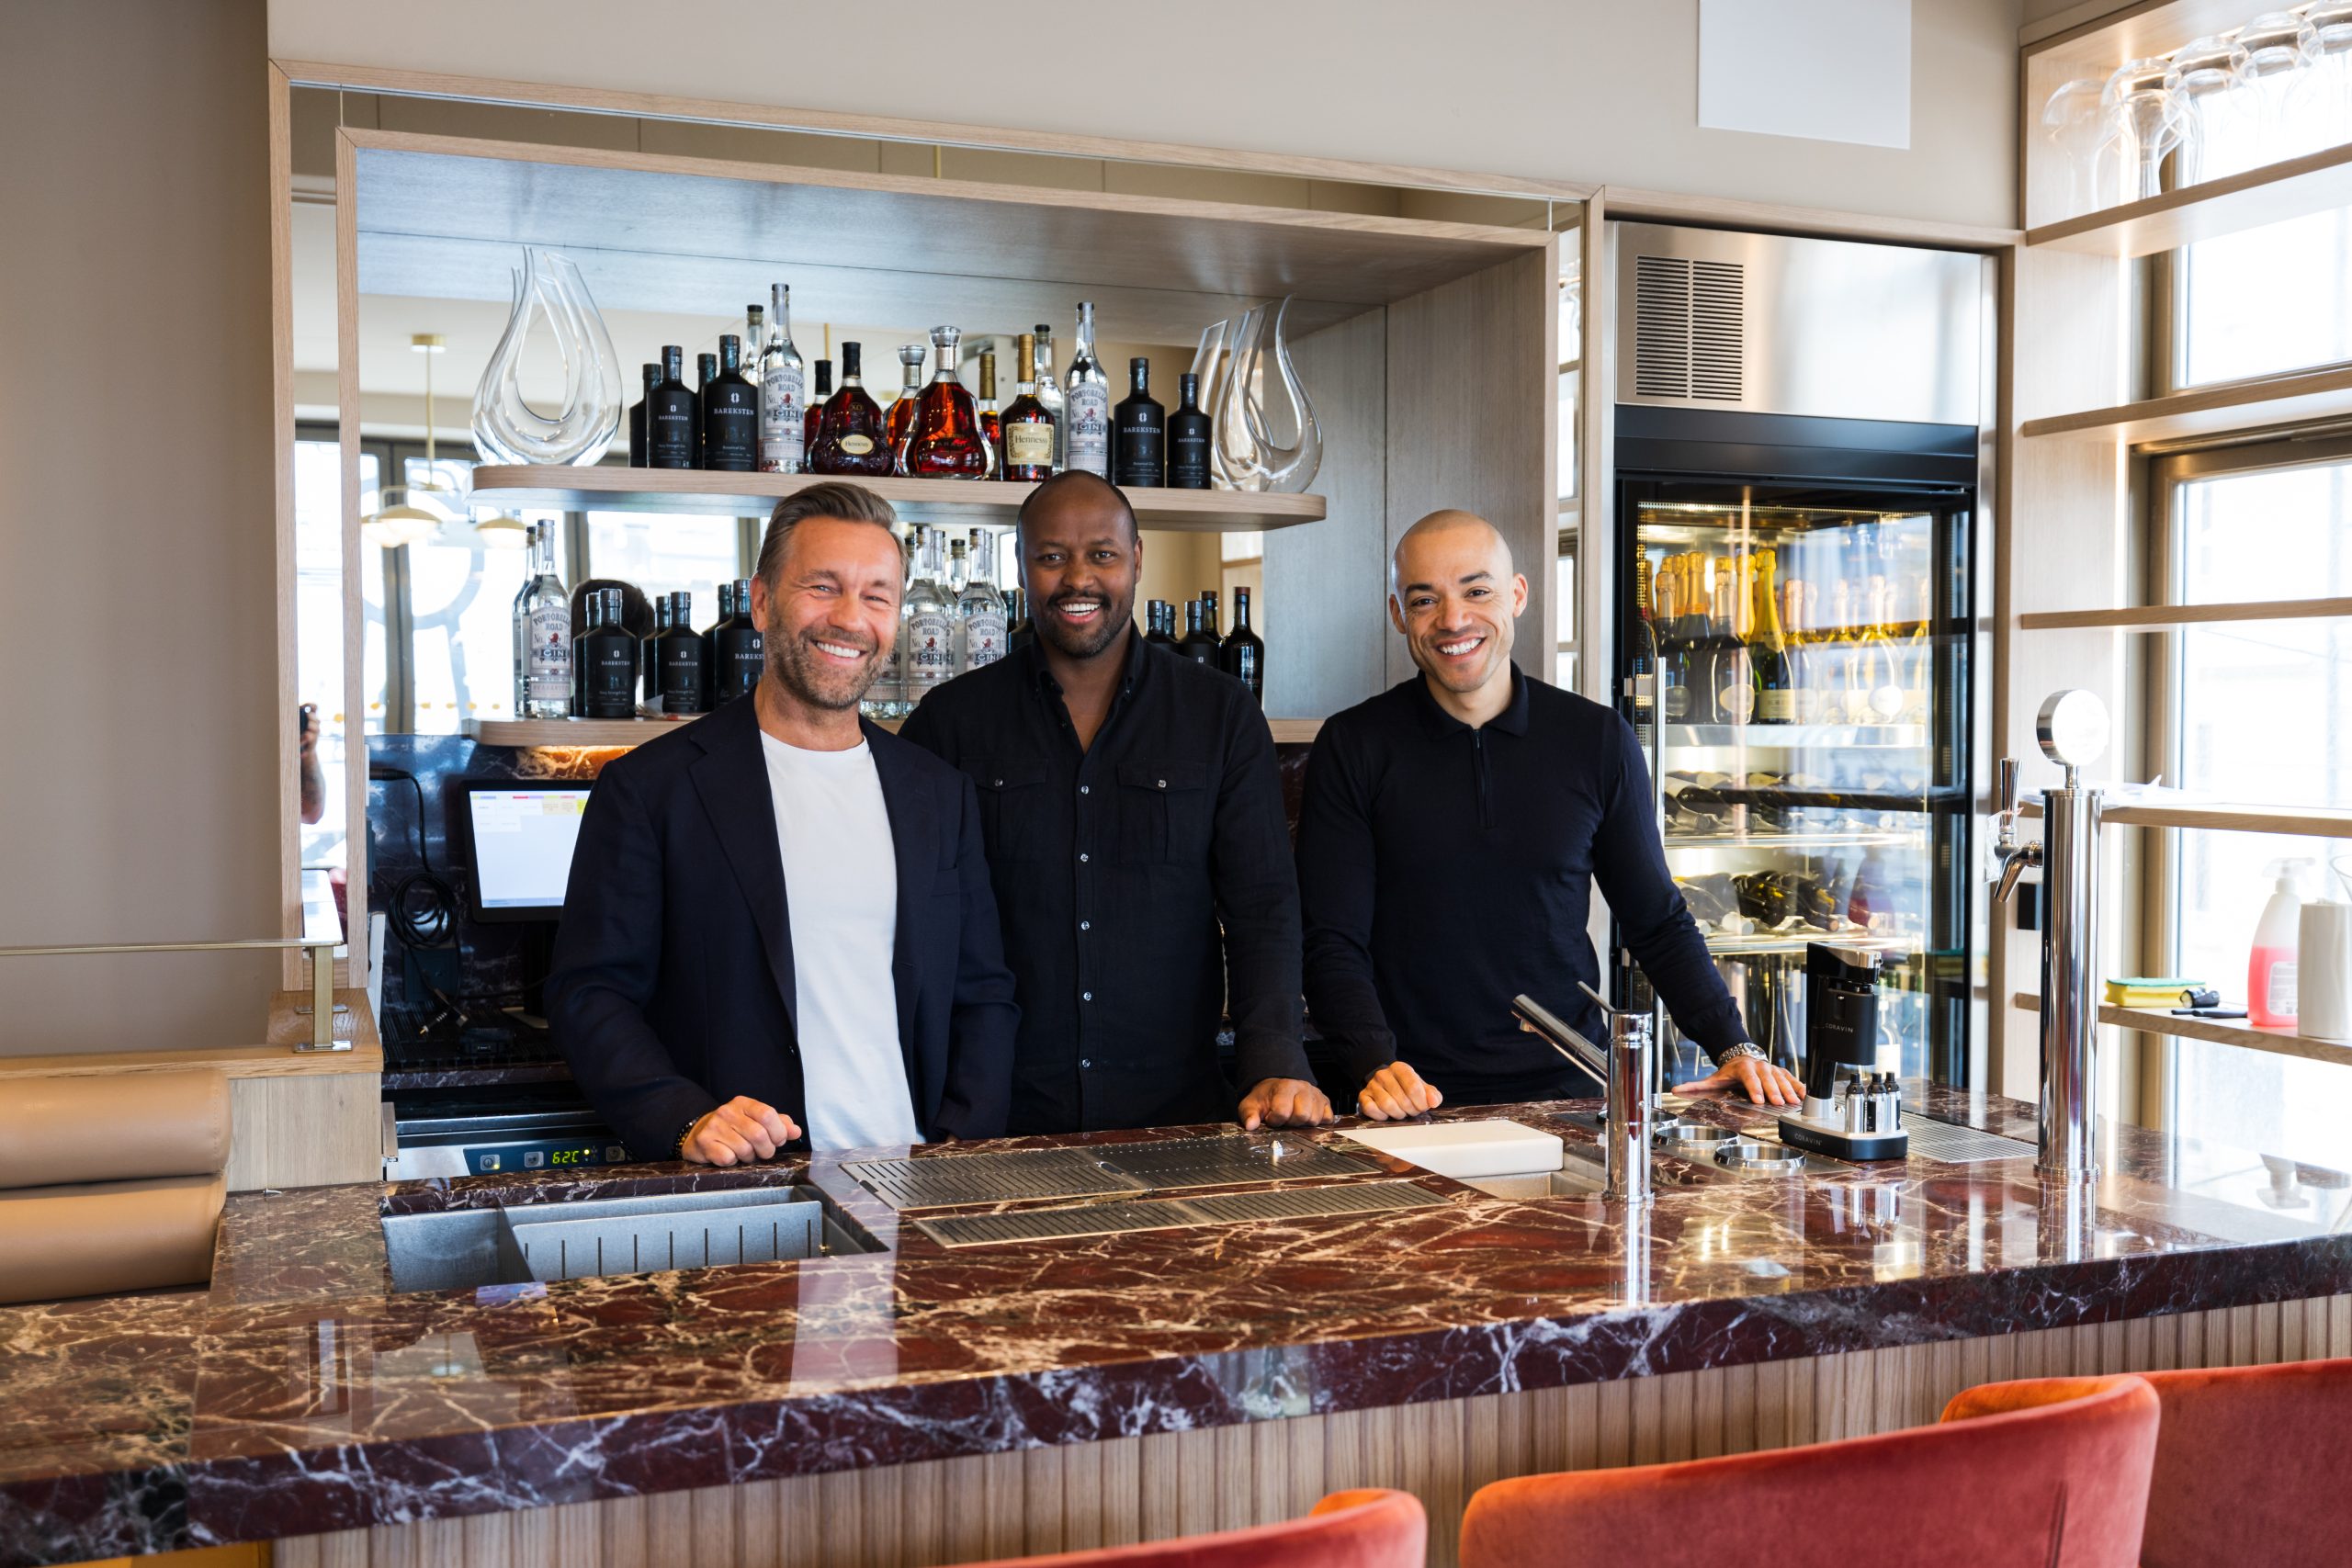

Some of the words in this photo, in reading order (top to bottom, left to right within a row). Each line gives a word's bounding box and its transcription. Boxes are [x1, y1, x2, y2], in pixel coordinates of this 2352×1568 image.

[778, 384, 796, 392] ROAD
[1081, 398, 1099, 406] ROAD
[714, 407, 754, 415] BAREKSTEN
[922, 627, 939, 636] ROAD
[1825, 1022, 1853, 1033] CORAVIN
[1794, 1133, 1821, 1145] CORAVIN
